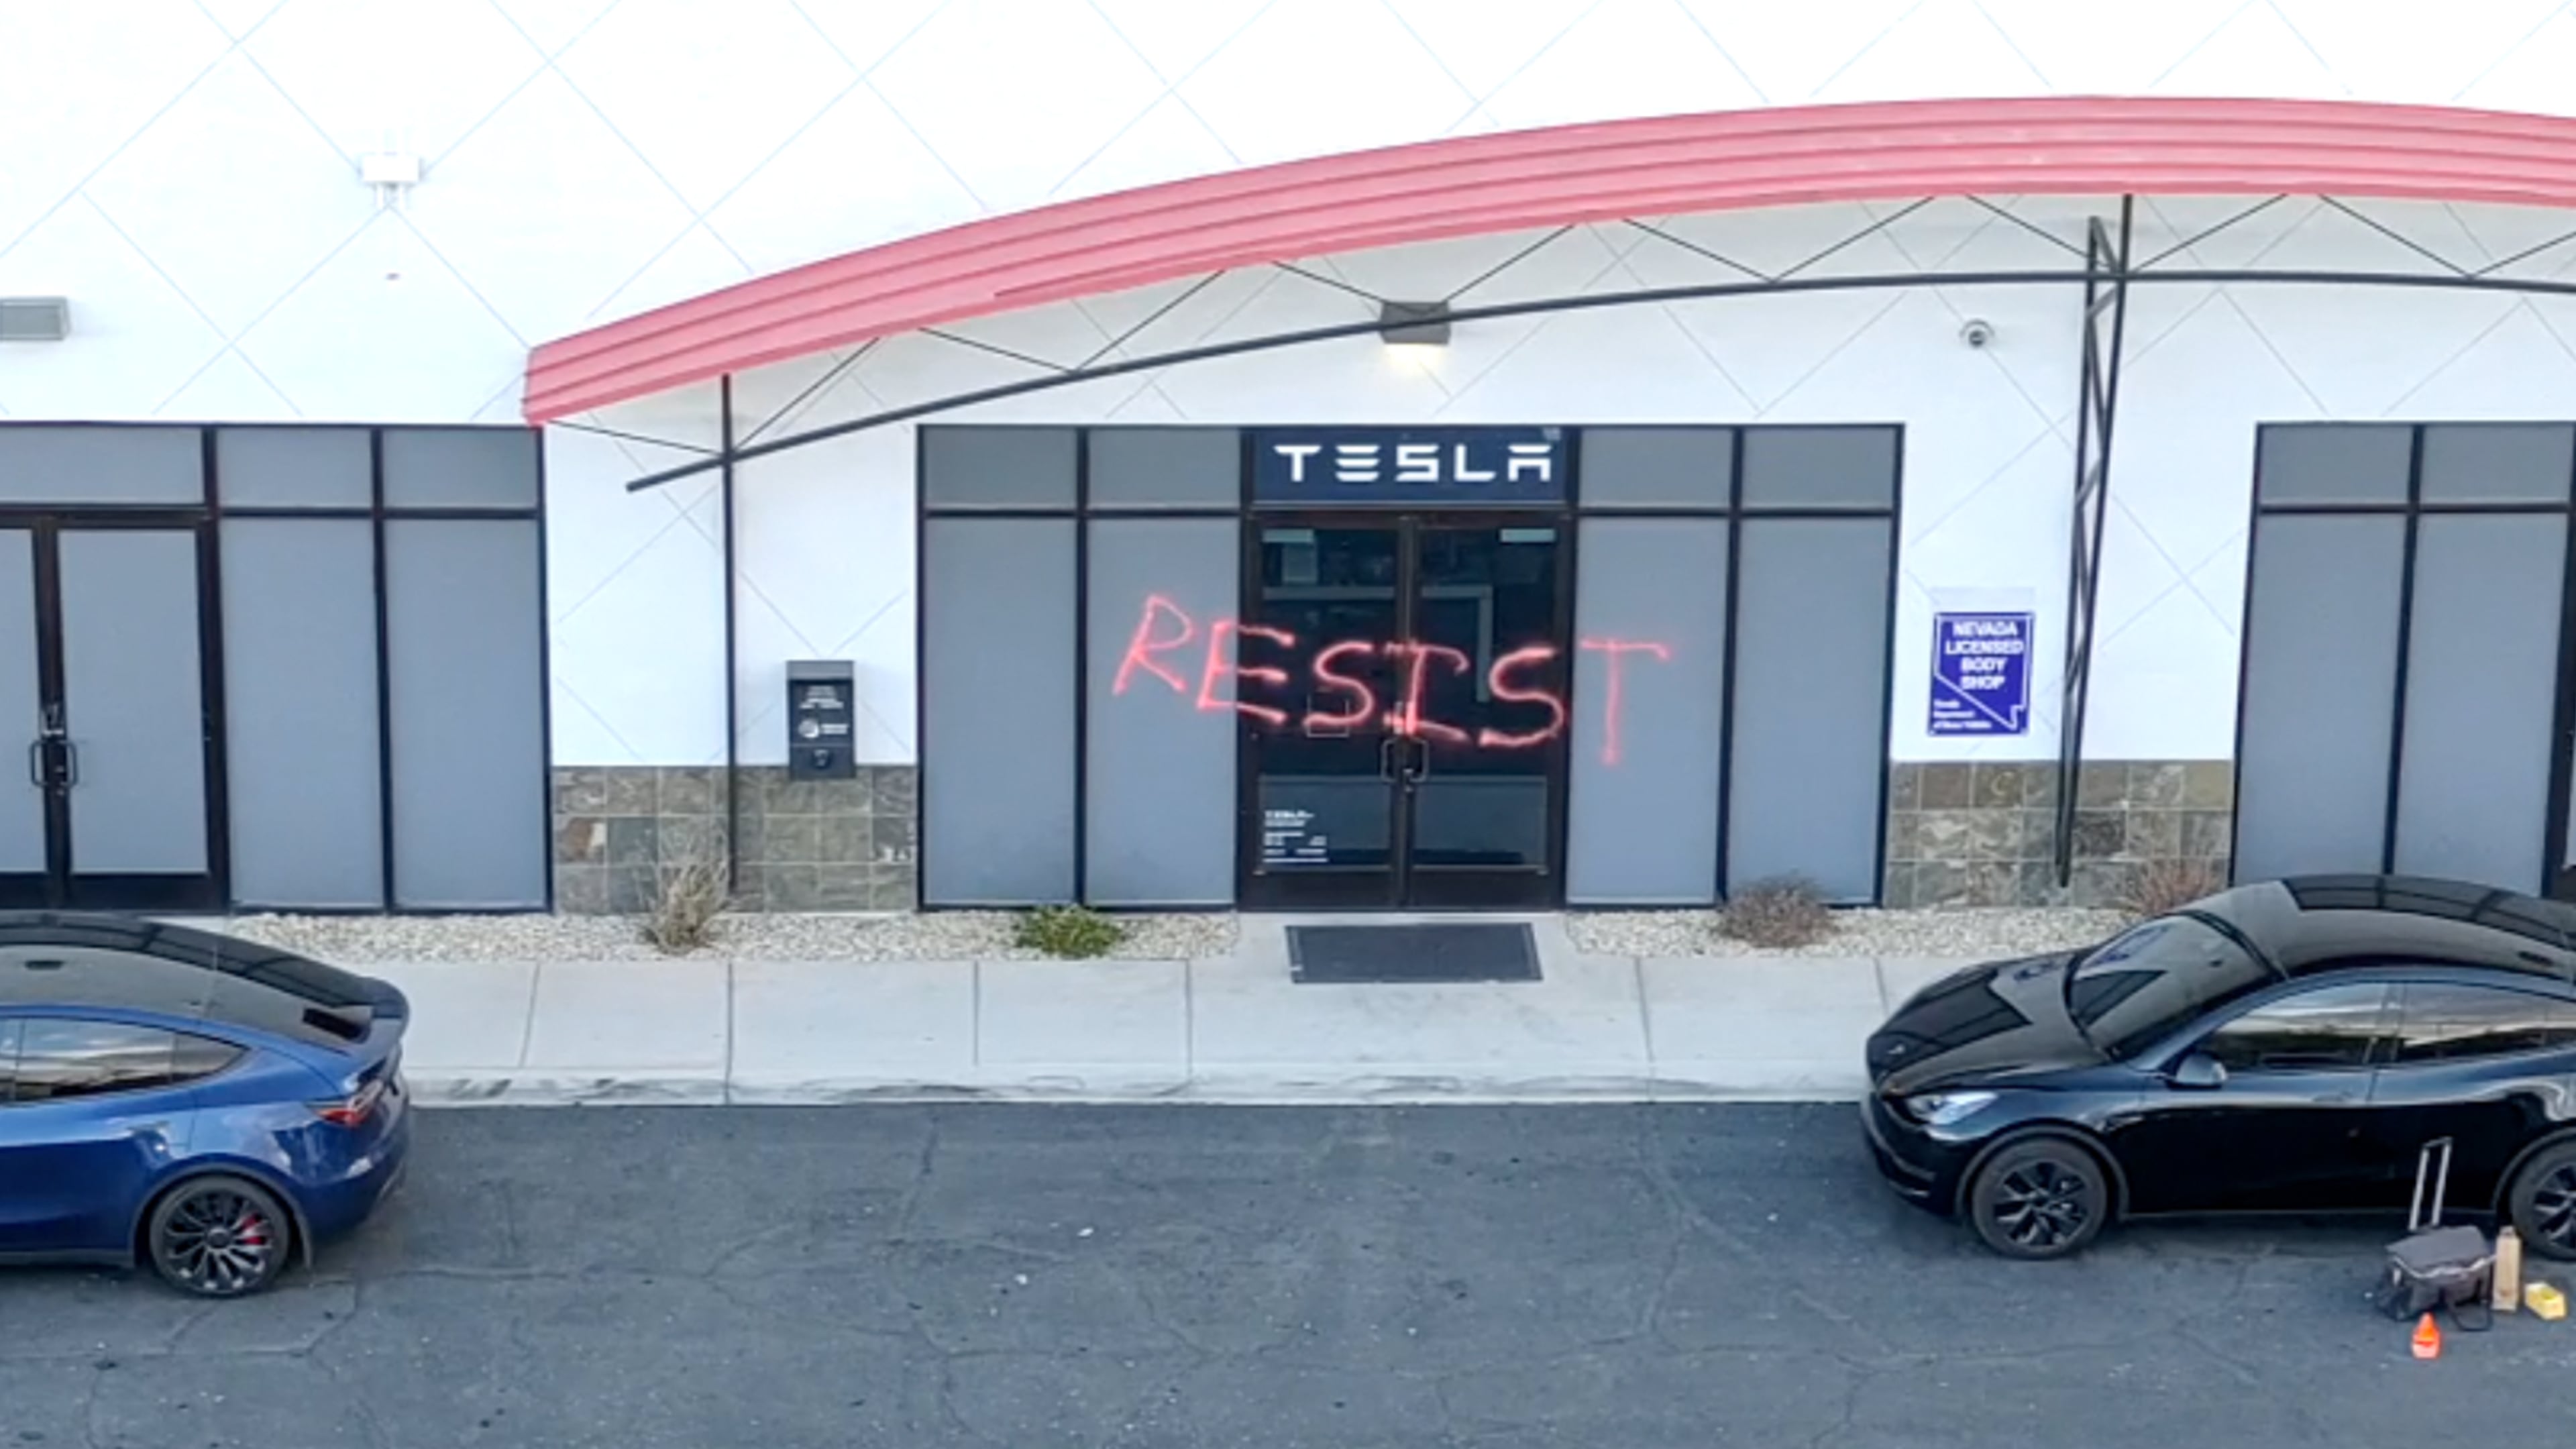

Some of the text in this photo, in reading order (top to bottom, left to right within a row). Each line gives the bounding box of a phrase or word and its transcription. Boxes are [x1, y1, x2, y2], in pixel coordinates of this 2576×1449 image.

[1273, 443, 1552, 482] TESLA
[1953, 621, 2019, 636] NEVADA
[1945, 640, 2024, 655] LICENSED
[1961, 657, 2008, 672] BODY
[1112, 593, 1672, 767] RESIST
[1960, 676, 2006, 690] SHOP
